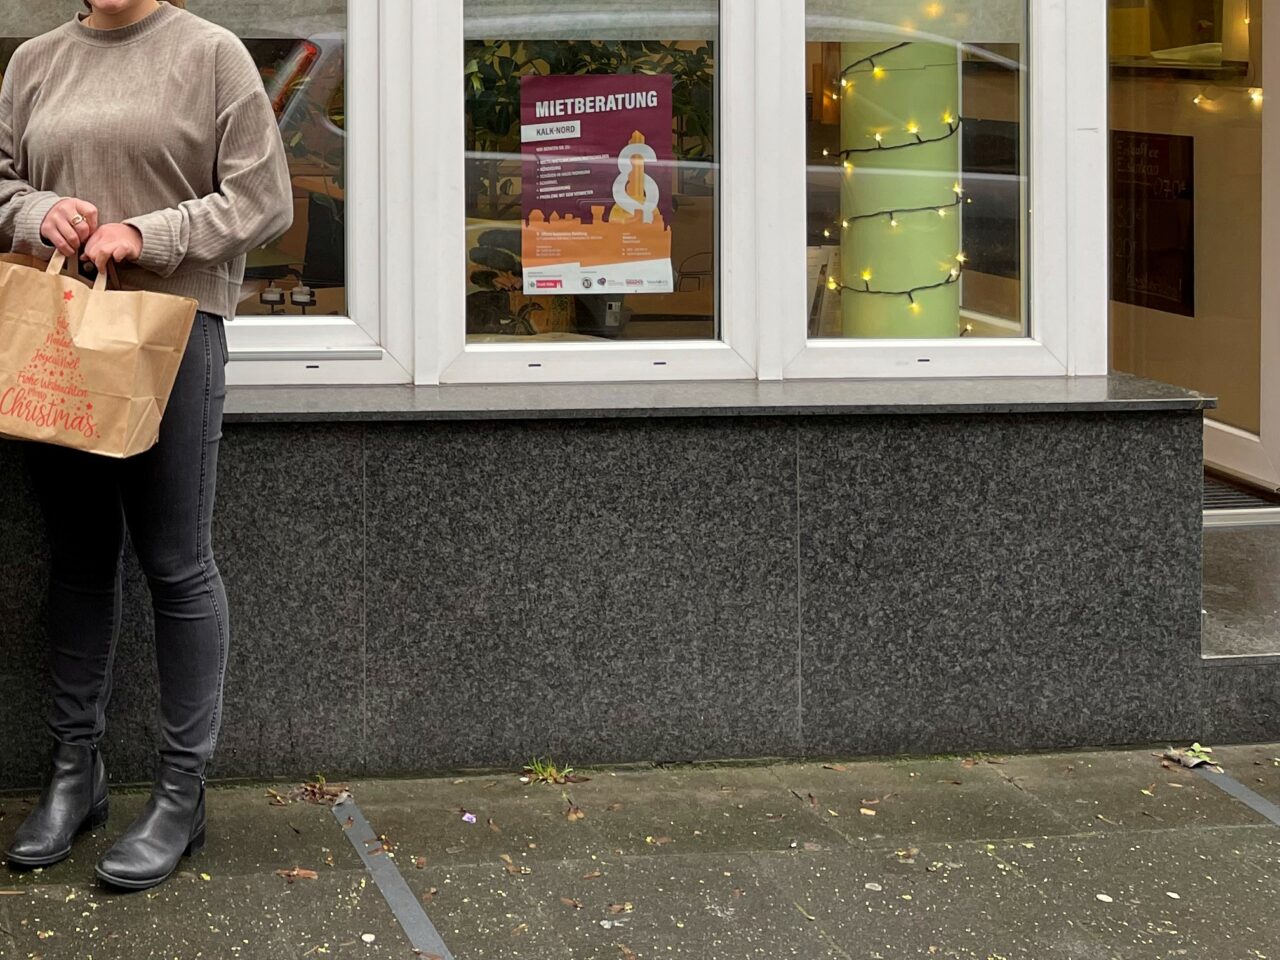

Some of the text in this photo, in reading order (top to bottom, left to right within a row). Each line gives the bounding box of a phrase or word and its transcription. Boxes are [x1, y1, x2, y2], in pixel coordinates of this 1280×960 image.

[535, 91, 658, 118] MIETBERATUNG
[536, 125, 576, 137] KALK-NORD
[0, 387, 97, 438] Christmas
